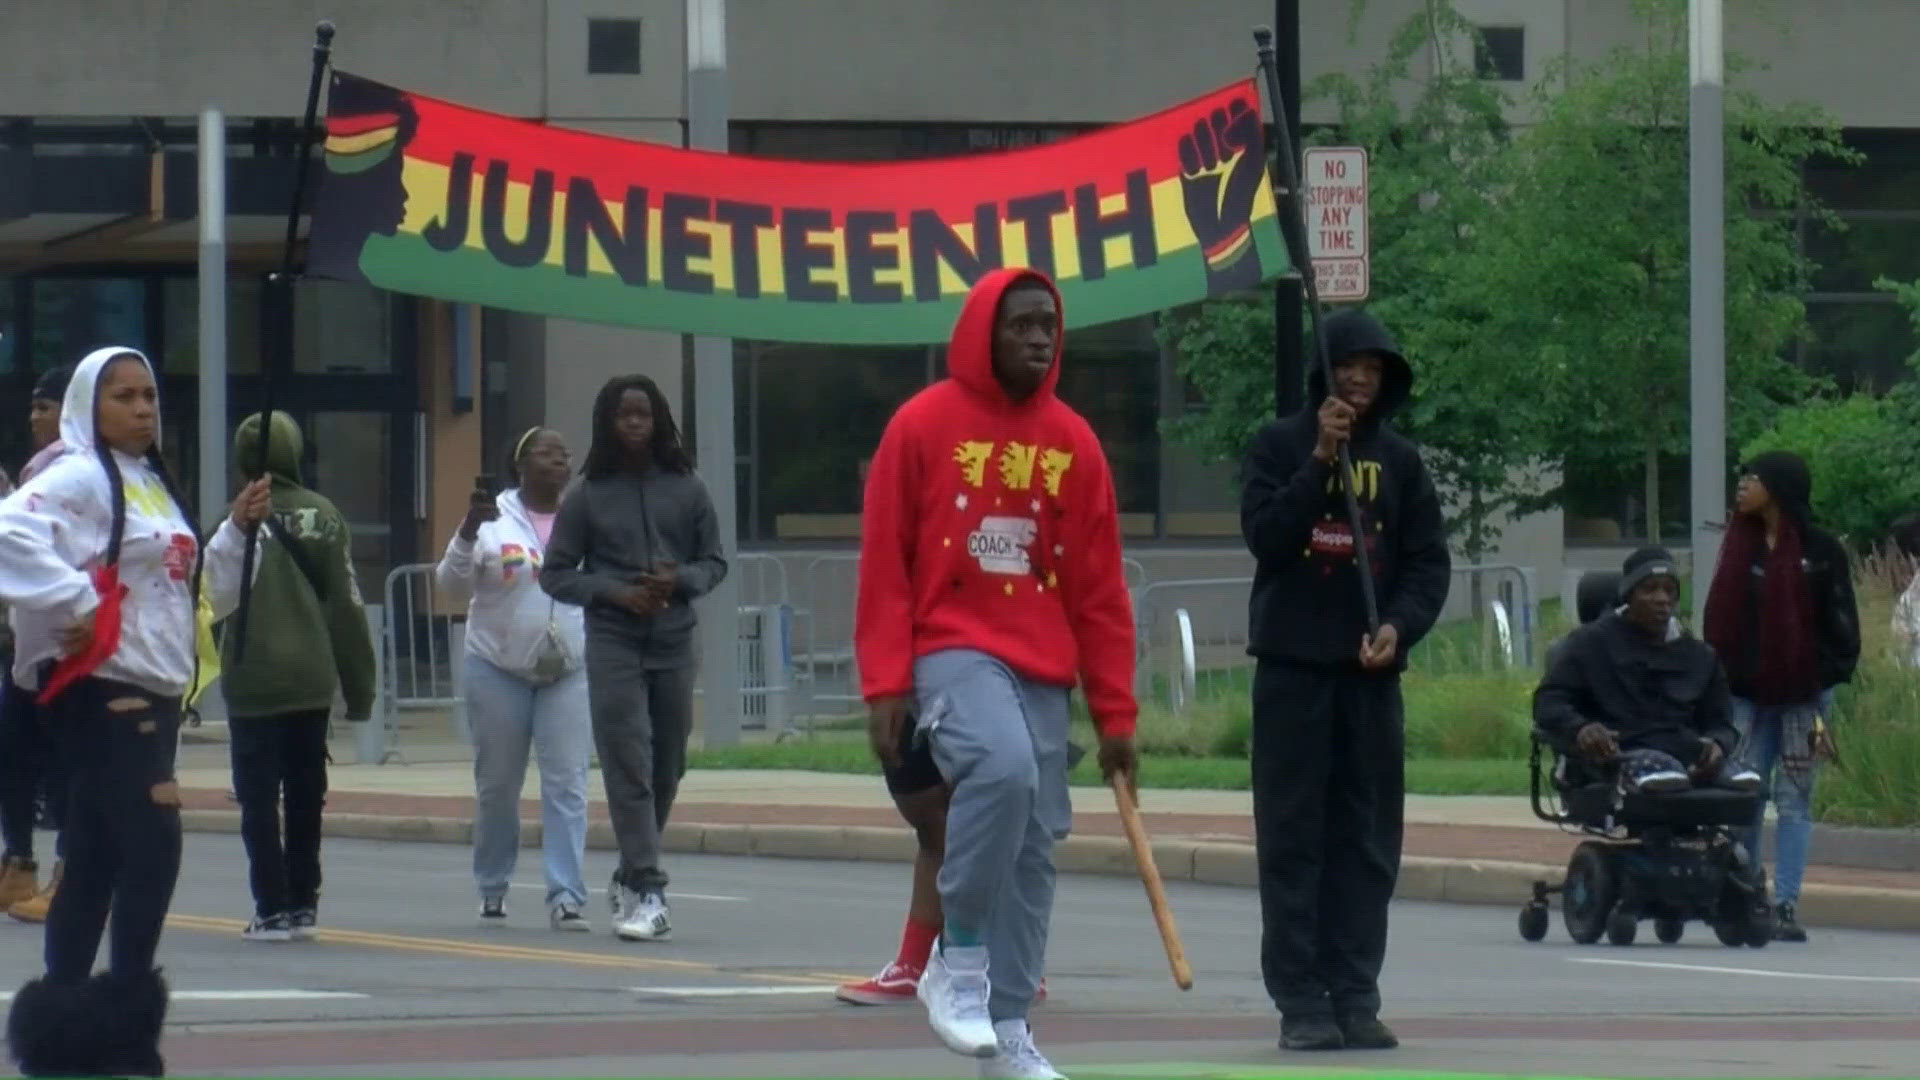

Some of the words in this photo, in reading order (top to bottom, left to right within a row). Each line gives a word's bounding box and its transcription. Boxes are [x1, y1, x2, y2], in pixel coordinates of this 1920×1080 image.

[1324, 159, 1347, 179] NO
[1310, 185, 1363, 205] STOPPING
[1321, 207, 1352, 226] ANY
[422, 151, 1158, 303] JUNETEENTH
[1319, 230, 1355, 250] TIME
[1338, 263, 1361, 277] SIDE
[1333, 279, 1357, 292] SIGN
[952, 440, 1074, 497] TNT
[968, 534, 1011, 554] COACH
